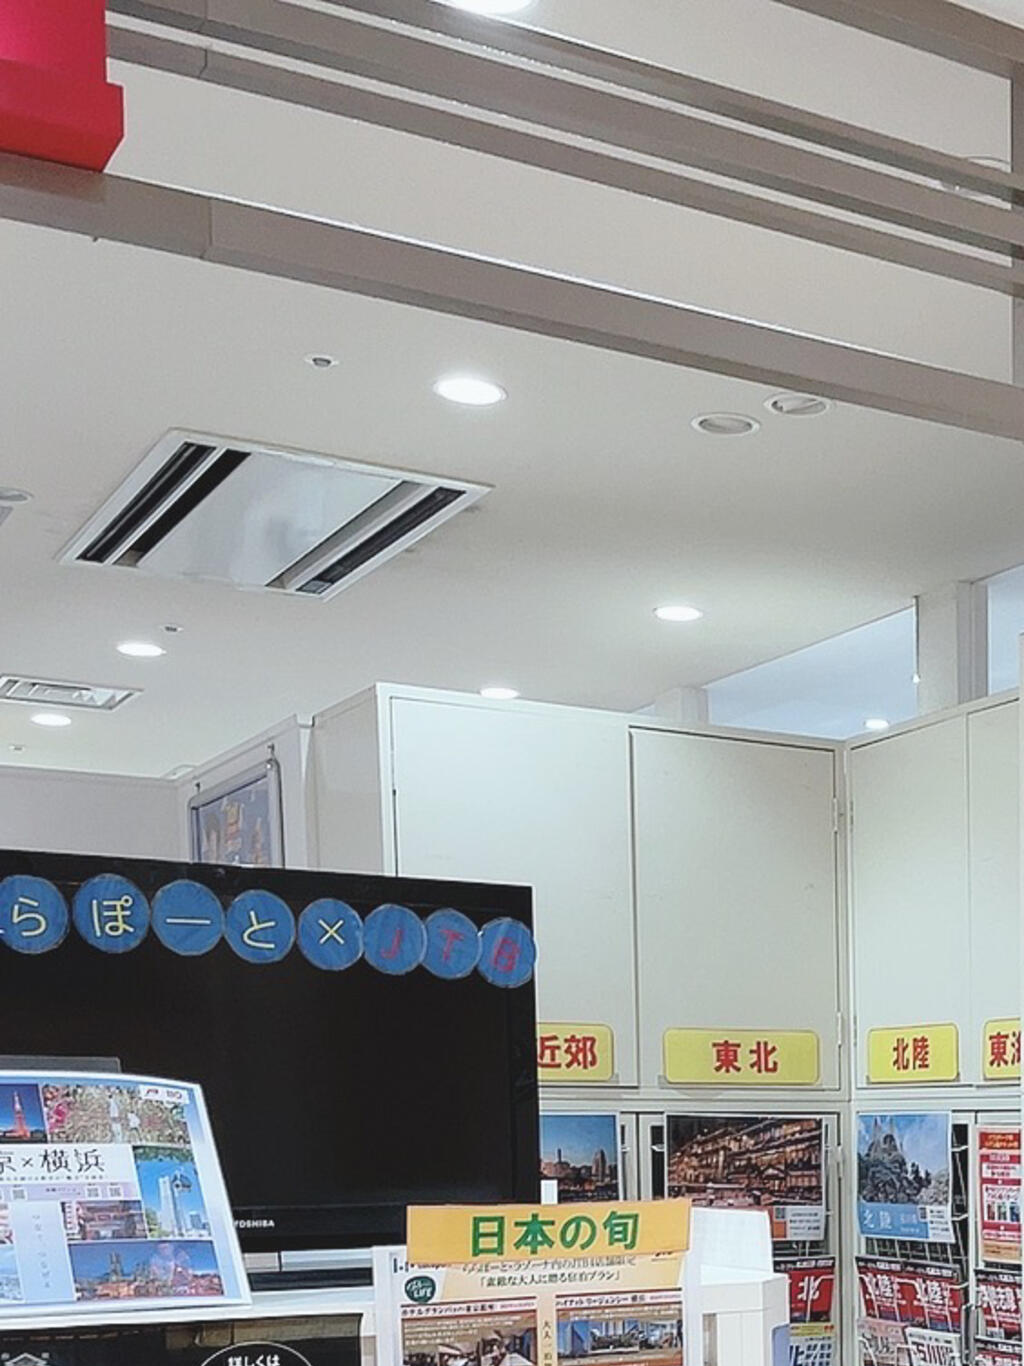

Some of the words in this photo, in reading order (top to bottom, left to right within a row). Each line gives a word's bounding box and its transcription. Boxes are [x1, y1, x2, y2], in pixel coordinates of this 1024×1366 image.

[0, 896, 520, 972] らぽーと×JTB
[712, 1040, 779, 1073] 東北
[893, 1036, 930, 1071] 北陸
[471, 1210, 639, 1257] 日本の旬
